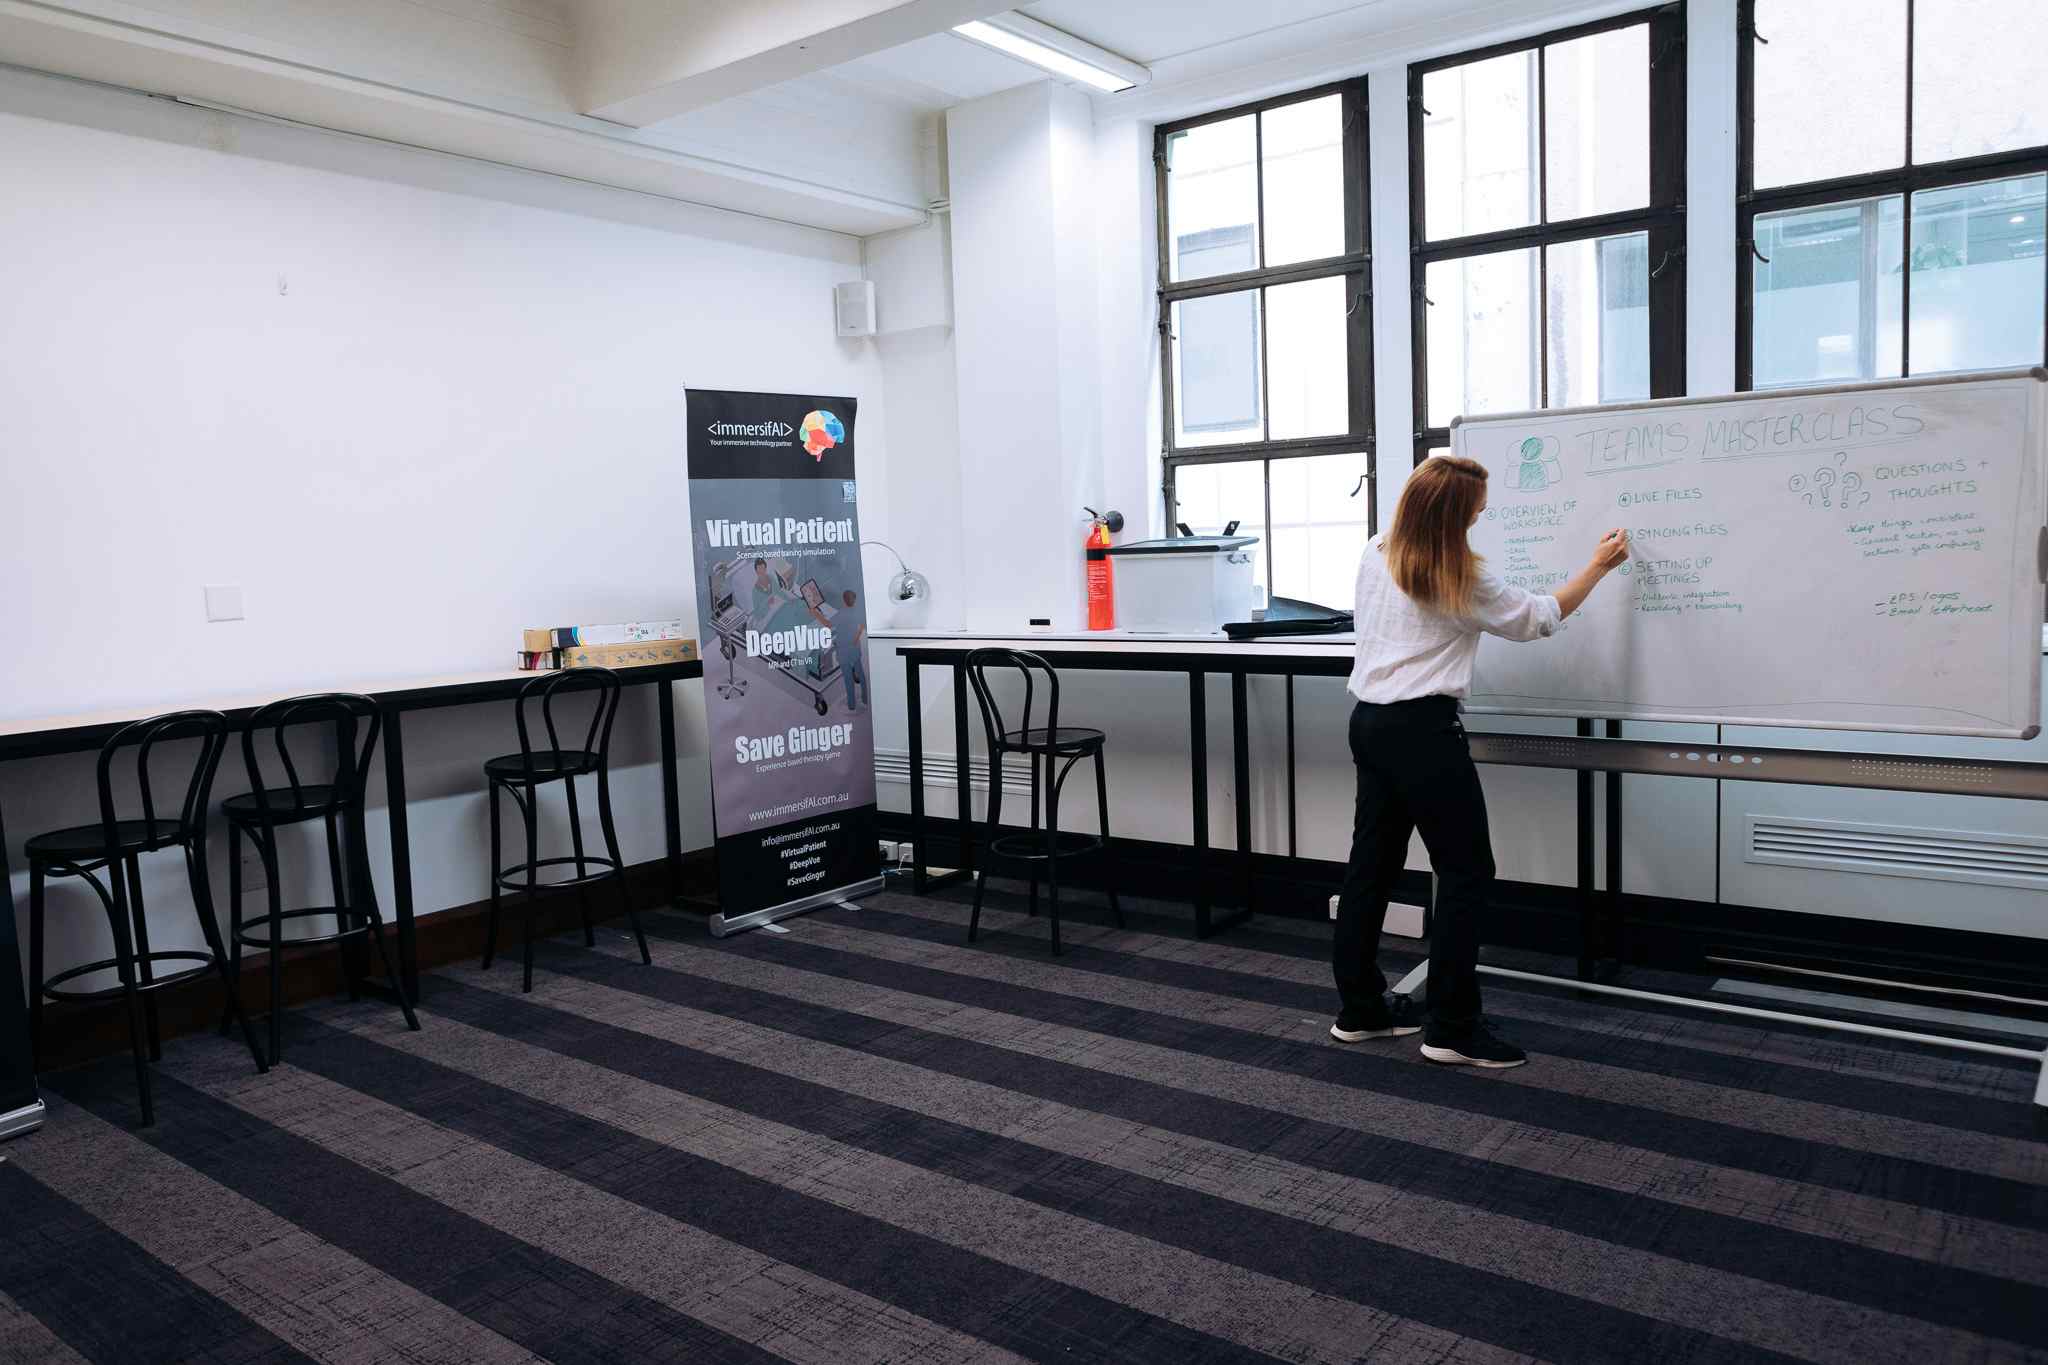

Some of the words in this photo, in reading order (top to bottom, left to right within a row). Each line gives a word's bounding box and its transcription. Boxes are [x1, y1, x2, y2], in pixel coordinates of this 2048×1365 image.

[710, 439, 723, 447] Your
[723, 439, 749, 447] immersive
[749, 440, 776, 448] technology
[776, 440, 793, 448] partner
[1576, 421, 1689, 464] TEAMS
[1703, 405, 1925, 457] MASTERCLASS
[1875, 459, 1967, 480] QUESTIONS
[1634, 491, 1658, 504] LIVE
[1665, 488, 1704, 501] FILES
[1888, 480, 1978, 502] THOUGHTS
[1501, 502, 1558, 520] OVERVIEW
[1563, 500, 1577, 513] OF
[706, 518, 781, 548] Virtual
[784, 517, 854, 545] Patient
[1503, 516, 1565, 531] WORKSPACE
[1694, 523, 1729, 537] FILES
[736, 551, 763, 561] Scenario
[763, 549, 781, 560] based
[781, 548, 802, 559] training
[803, 547, 836, 557] simulation
[1637, 559, 1692, 577] SETTING
[1697, 557, 1713, 569] UP
[1528, 570, 1569, 586] PARTY
[1637, 573, 1702, 586] MEETINGS
[745, 625, 833, 658] DeepVue
[735, 734, 785, 764] Save
[788, 723, 853, 755] Ginger
[755, 761, 787, 773] Experience
[803, 754, 825, 767] therapy
[825, 751, 841, 762] game
[749, 792, 849, 822] www.immersifAI.com.au
[780, 840, 827, 859] #VirtualPatient
[789, 855, 821, 871] #DeepVue
[787, 869, 826, 887] #SaveGinger
